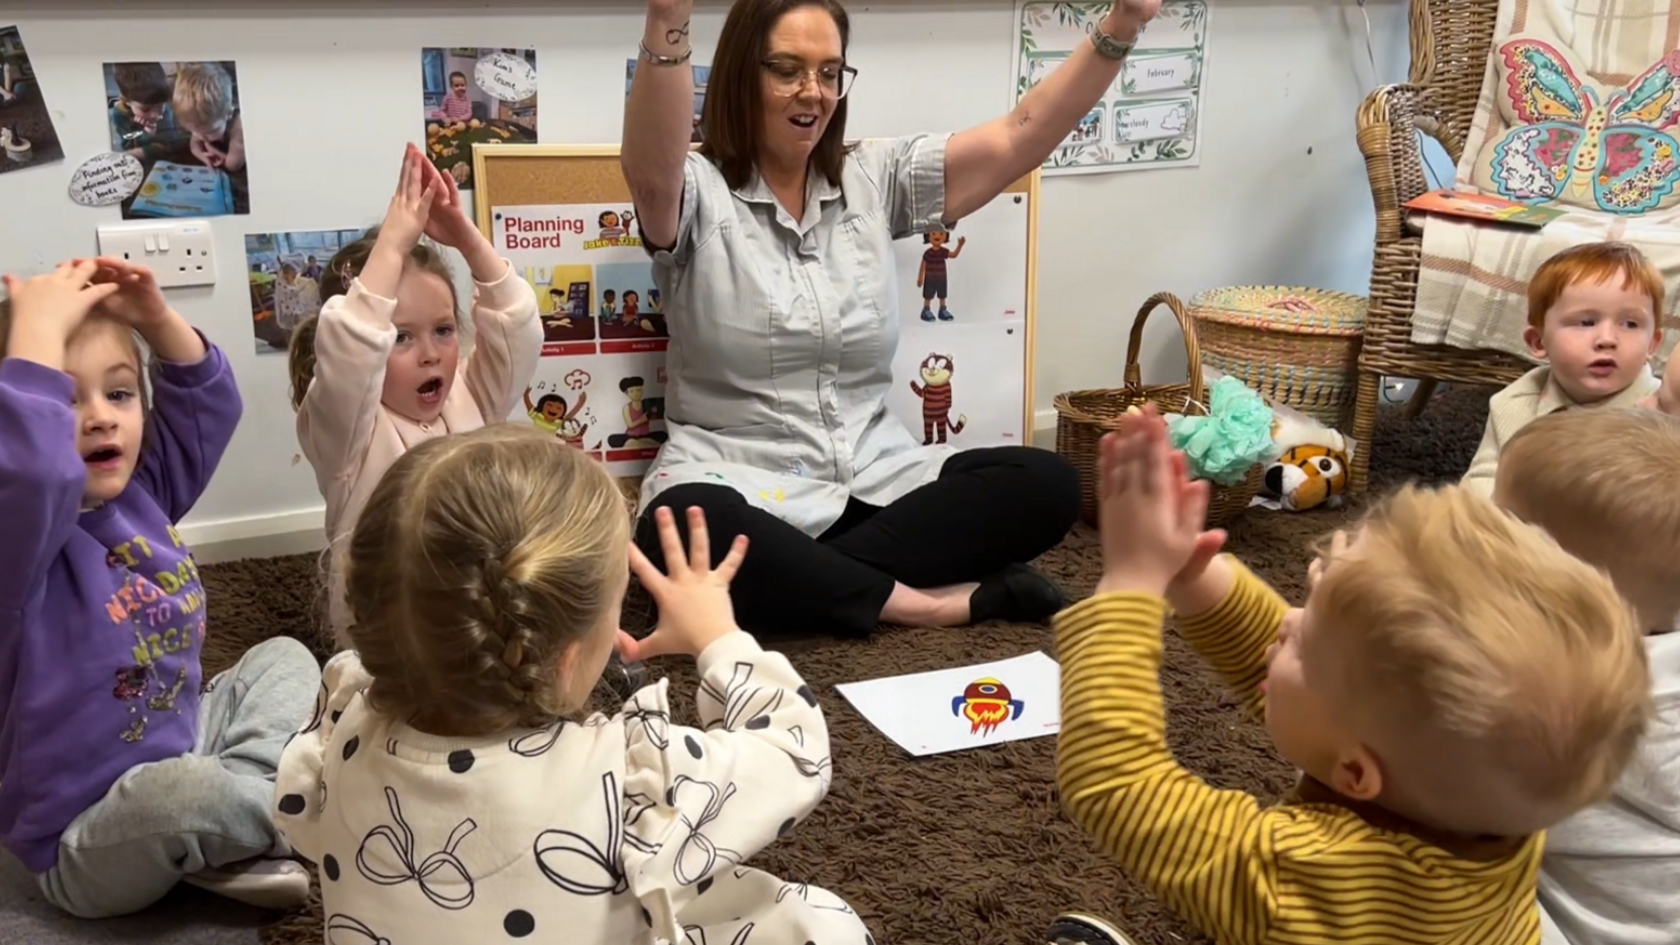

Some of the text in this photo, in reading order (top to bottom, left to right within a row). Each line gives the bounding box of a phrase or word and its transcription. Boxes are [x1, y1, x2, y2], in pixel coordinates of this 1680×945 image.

[1147, 69, 1175, 78] February
[1130, 118, 1149, 129] cloudy
[504, 216, 584, 234] Planning
[505, 233, 561, 249] Board
[619, 236, 642, 247] Tizz
[146, 602, 171, 627] TO
